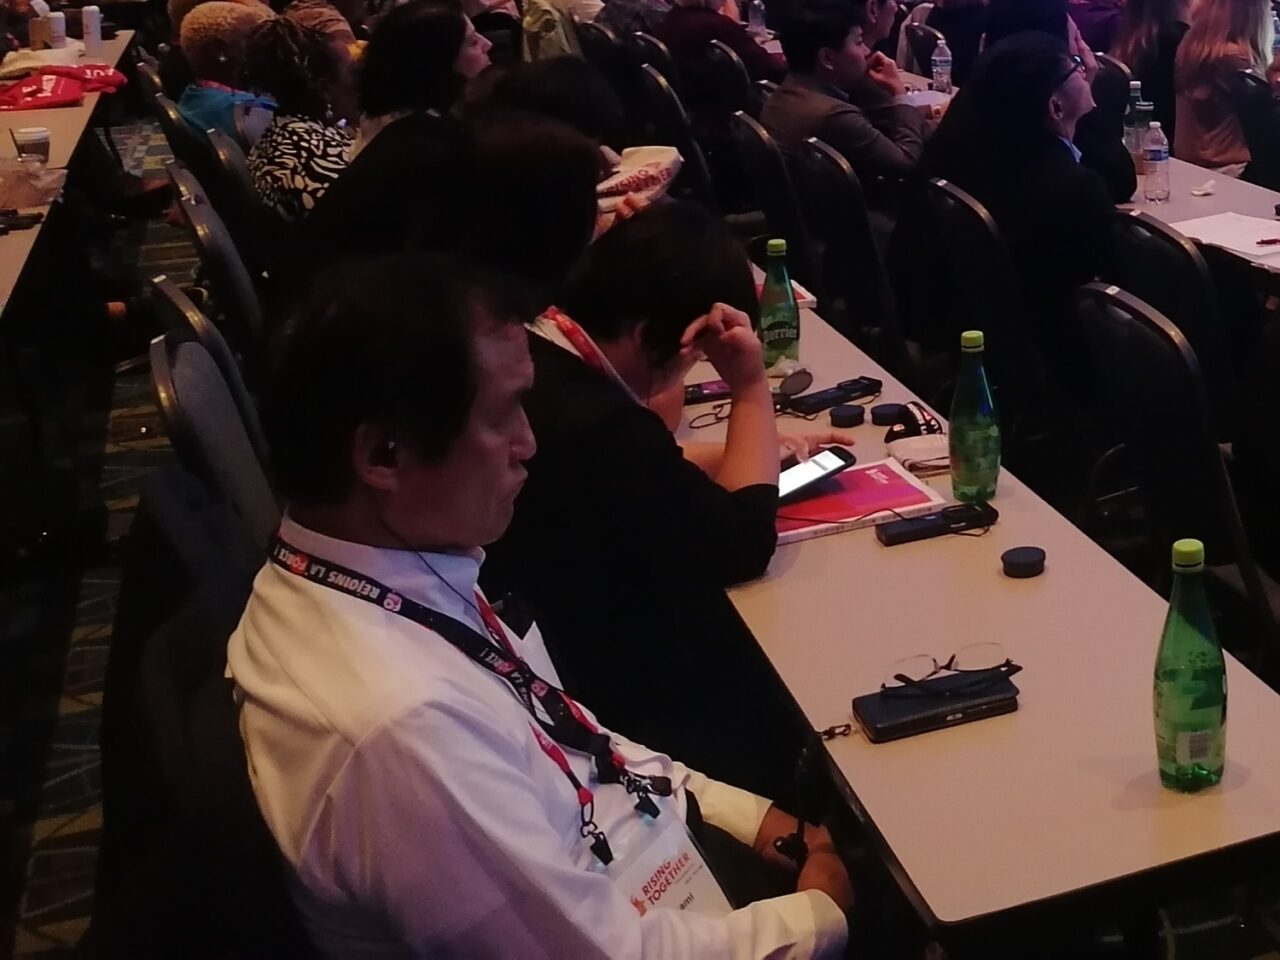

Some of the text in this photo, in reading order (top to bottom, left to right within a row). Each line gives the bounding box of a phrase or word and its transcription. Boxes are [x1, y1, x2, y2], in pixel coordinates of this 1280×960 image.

[309, 563, 326, 578] LA
[641, 858, 672, 897] RISING
[646, 852, 690, 906] TOGETHER
